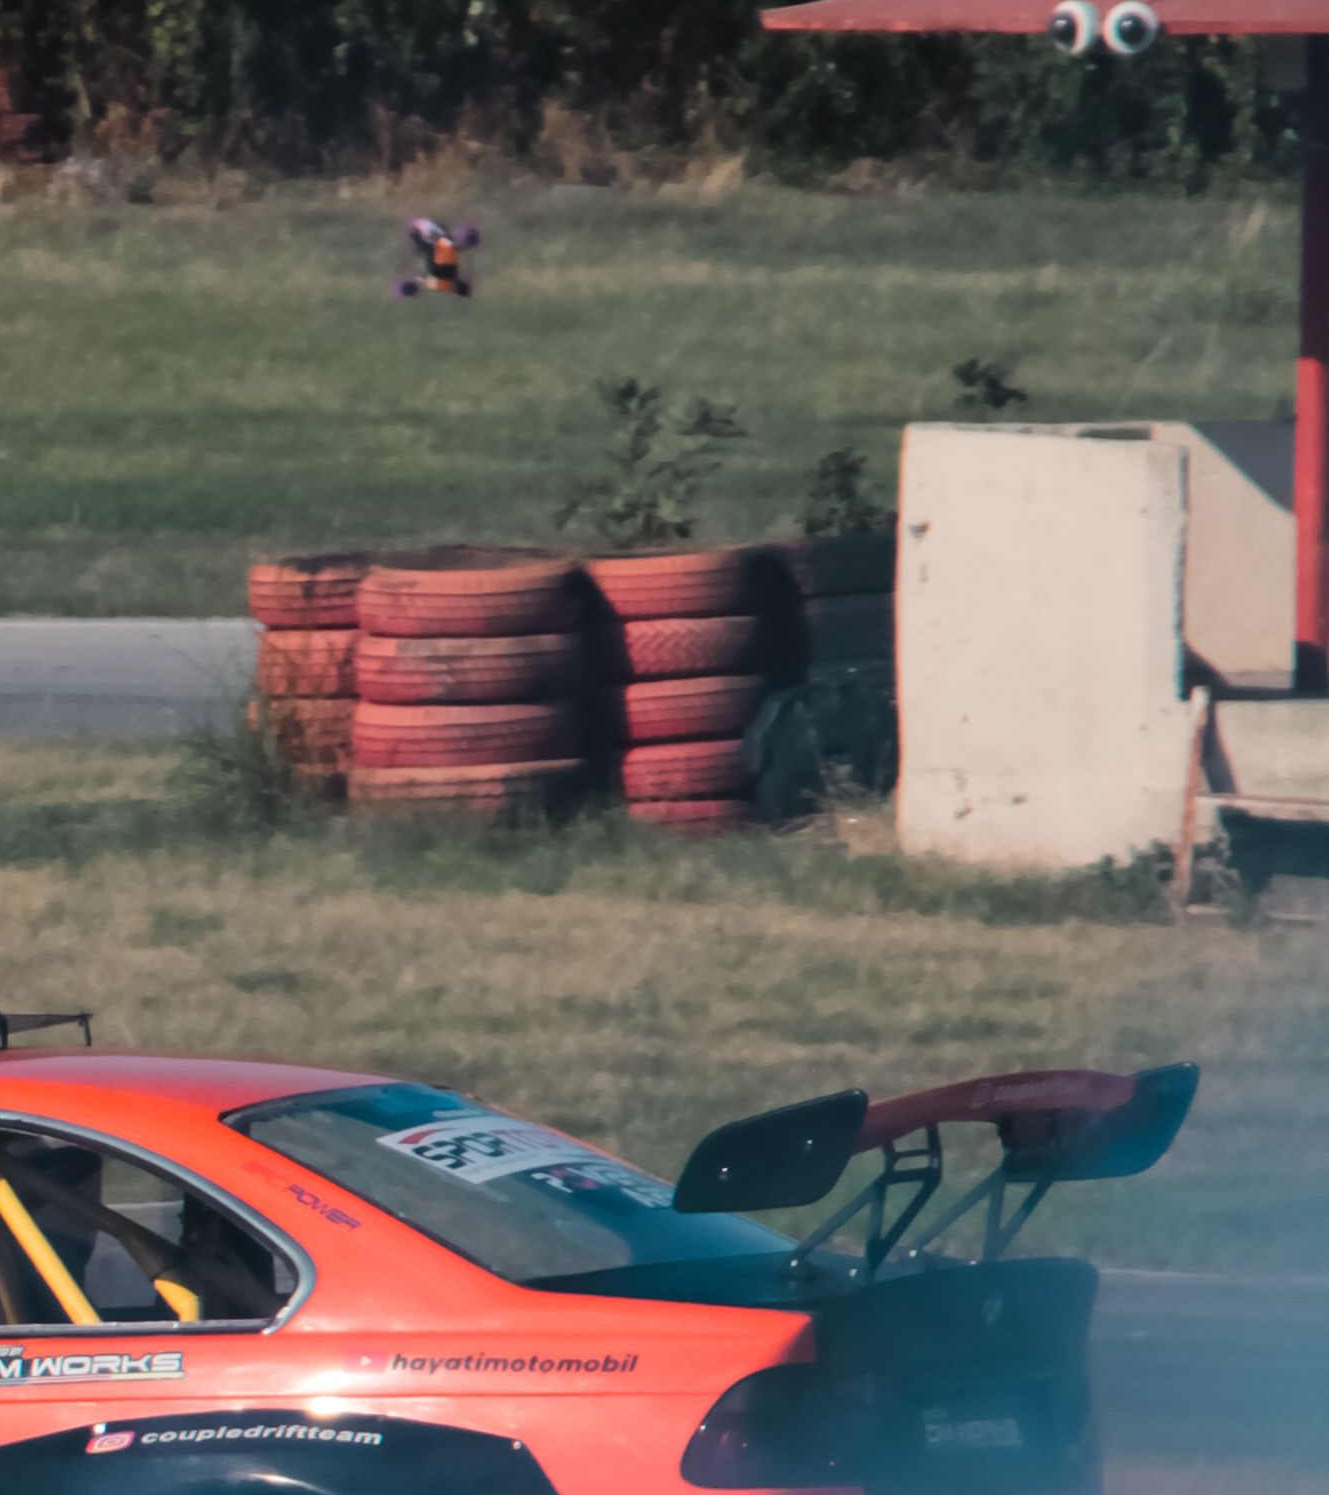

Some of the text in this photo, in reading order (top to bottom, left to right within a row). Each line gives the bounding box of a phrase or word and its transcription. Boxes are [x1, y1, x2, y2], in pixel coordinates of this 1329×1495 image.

[287, 1183, 363, 1231] POWER
[30, 1353, 183, 1376] WORKS
[391, 1353, 640, 1376] hayatimotomobil
[141, 1424, 383, 1446] coupledriftteam
